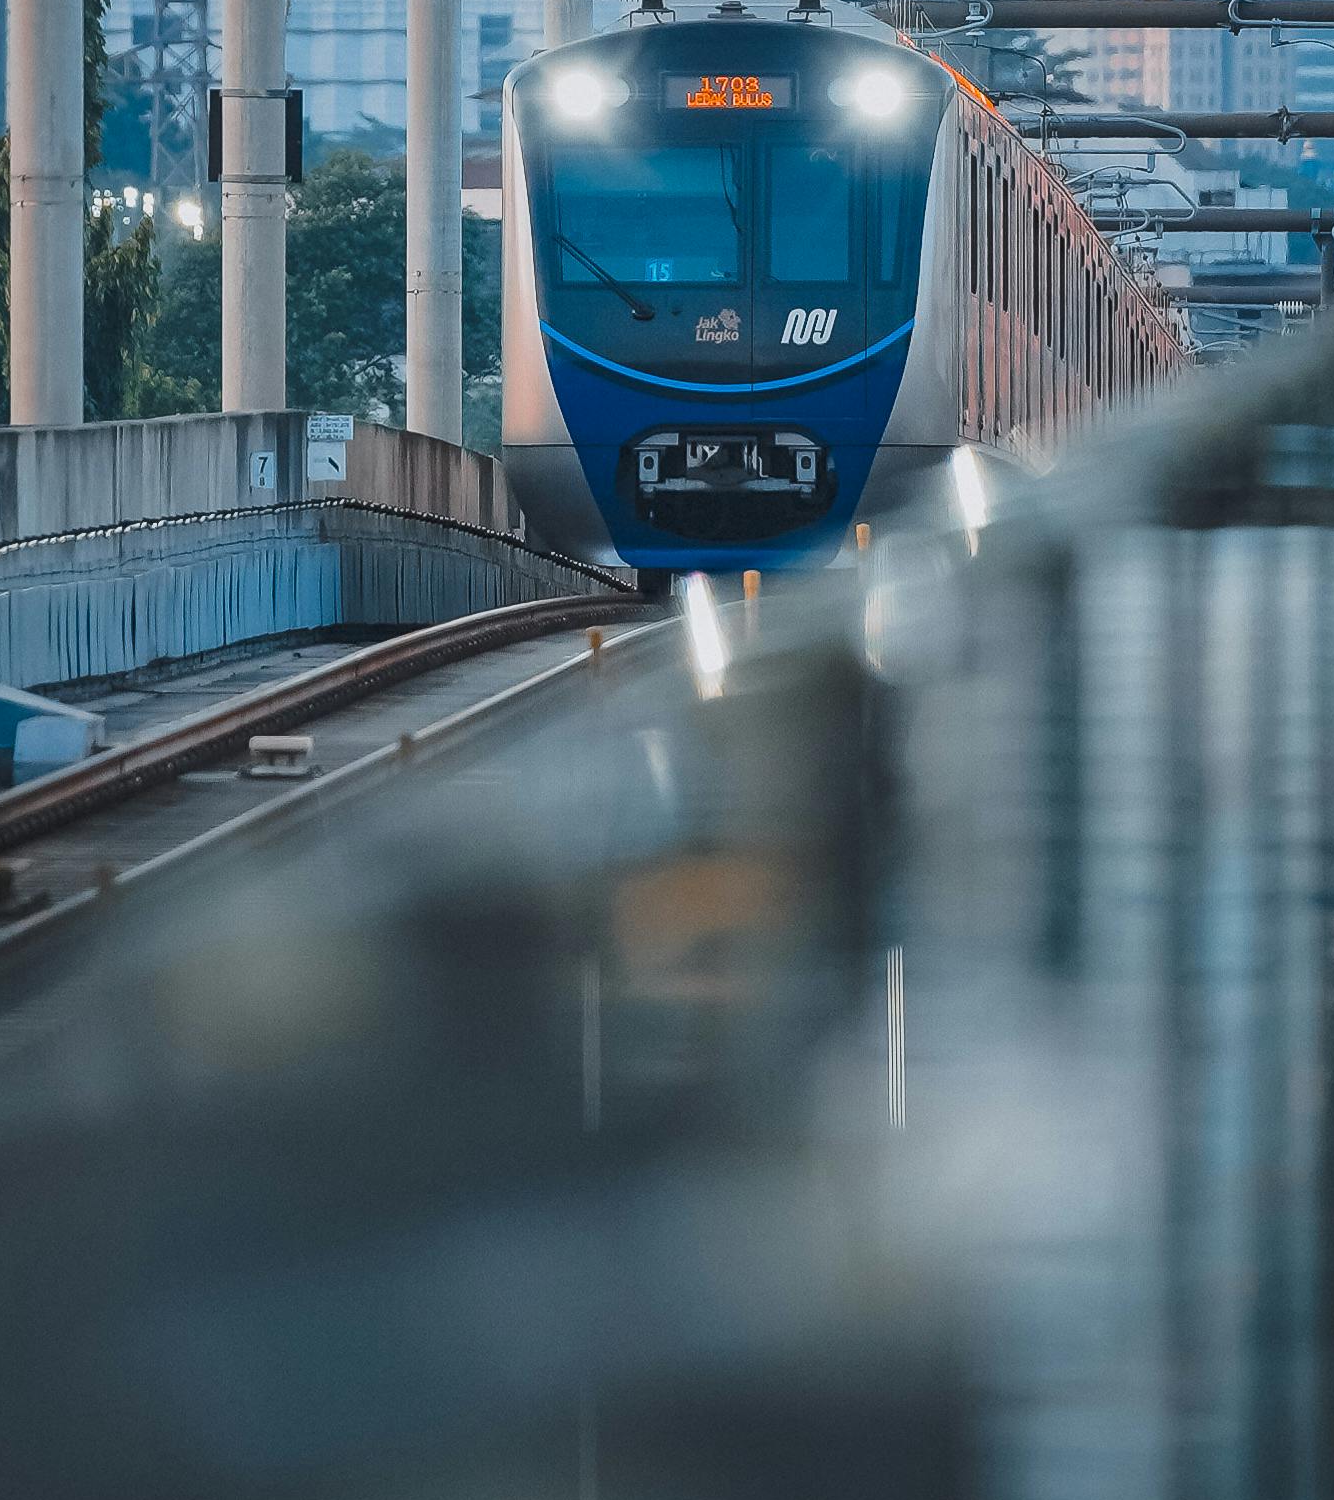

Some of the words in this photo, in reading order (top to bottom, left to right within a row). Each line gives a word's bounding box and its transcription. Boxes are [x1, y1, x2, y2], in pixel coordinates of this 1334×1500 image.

[648, 262, 670, 281] 15
[695, 316, 719, 330] Jak
[695, 329, 740, 345] Lingko
[258, 456, 269, 474] 7
